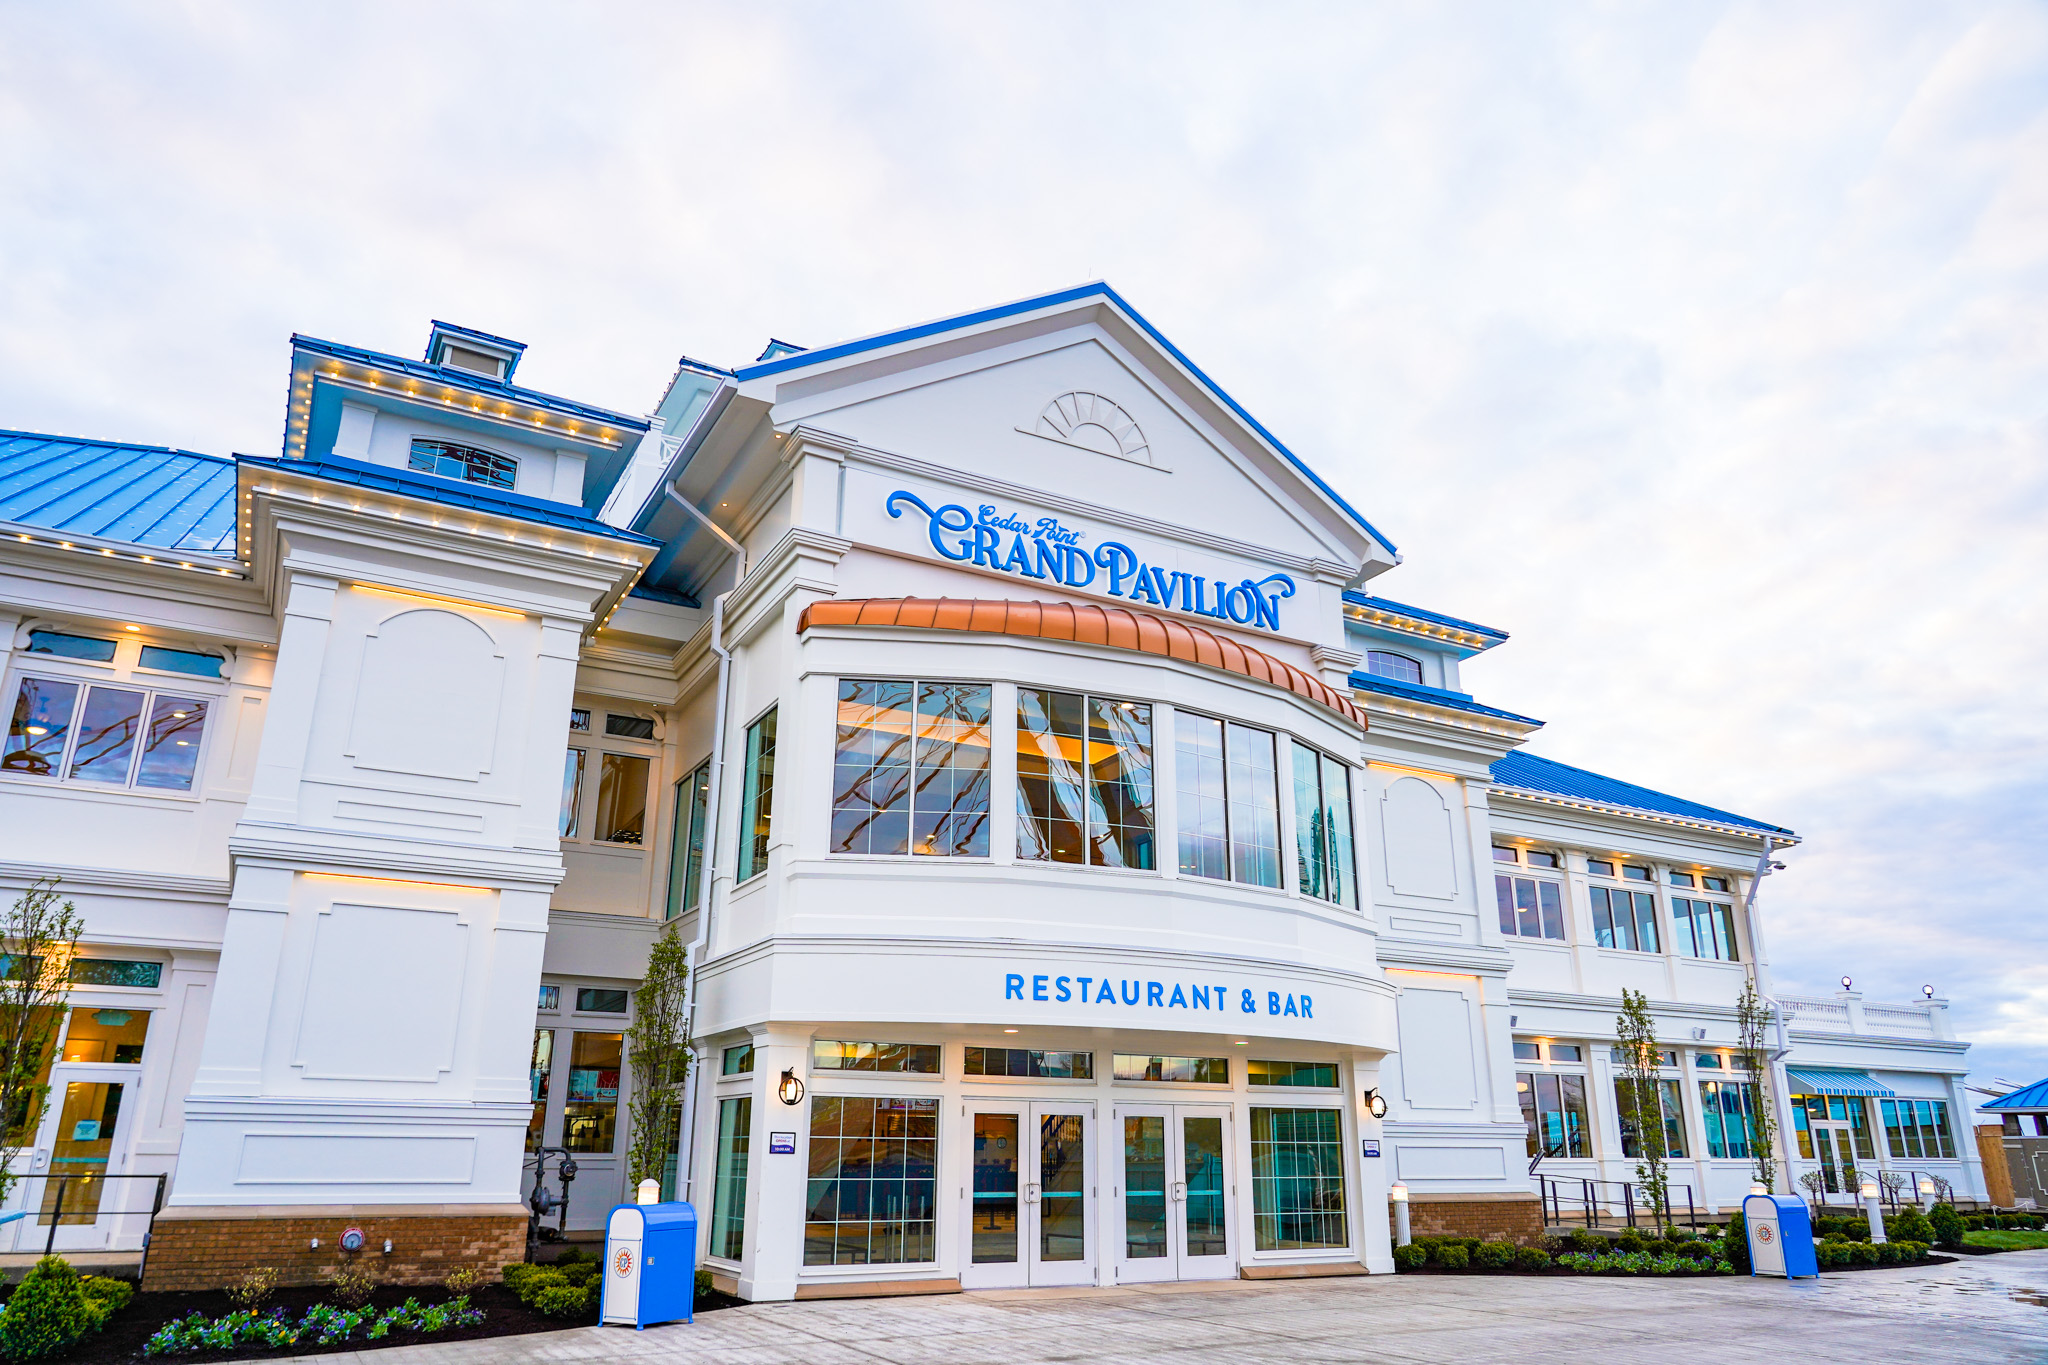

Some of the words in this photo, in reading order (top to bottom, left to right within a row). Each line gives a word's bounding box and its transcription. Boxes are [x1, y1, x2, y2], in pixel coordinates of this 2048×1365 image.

[978, 504, 1031, 535] Cedar
[1031, 517, 1080, 546] Point
[886, 490, 1096, 588] GRAND
[1094, 541, 1297, 632] PAVILION
[1005, 973, 1227, 1011] RESTAURANT
[1241, 988, 1257, 1013] &
[1268, 991, 1314, 1019] BAR
